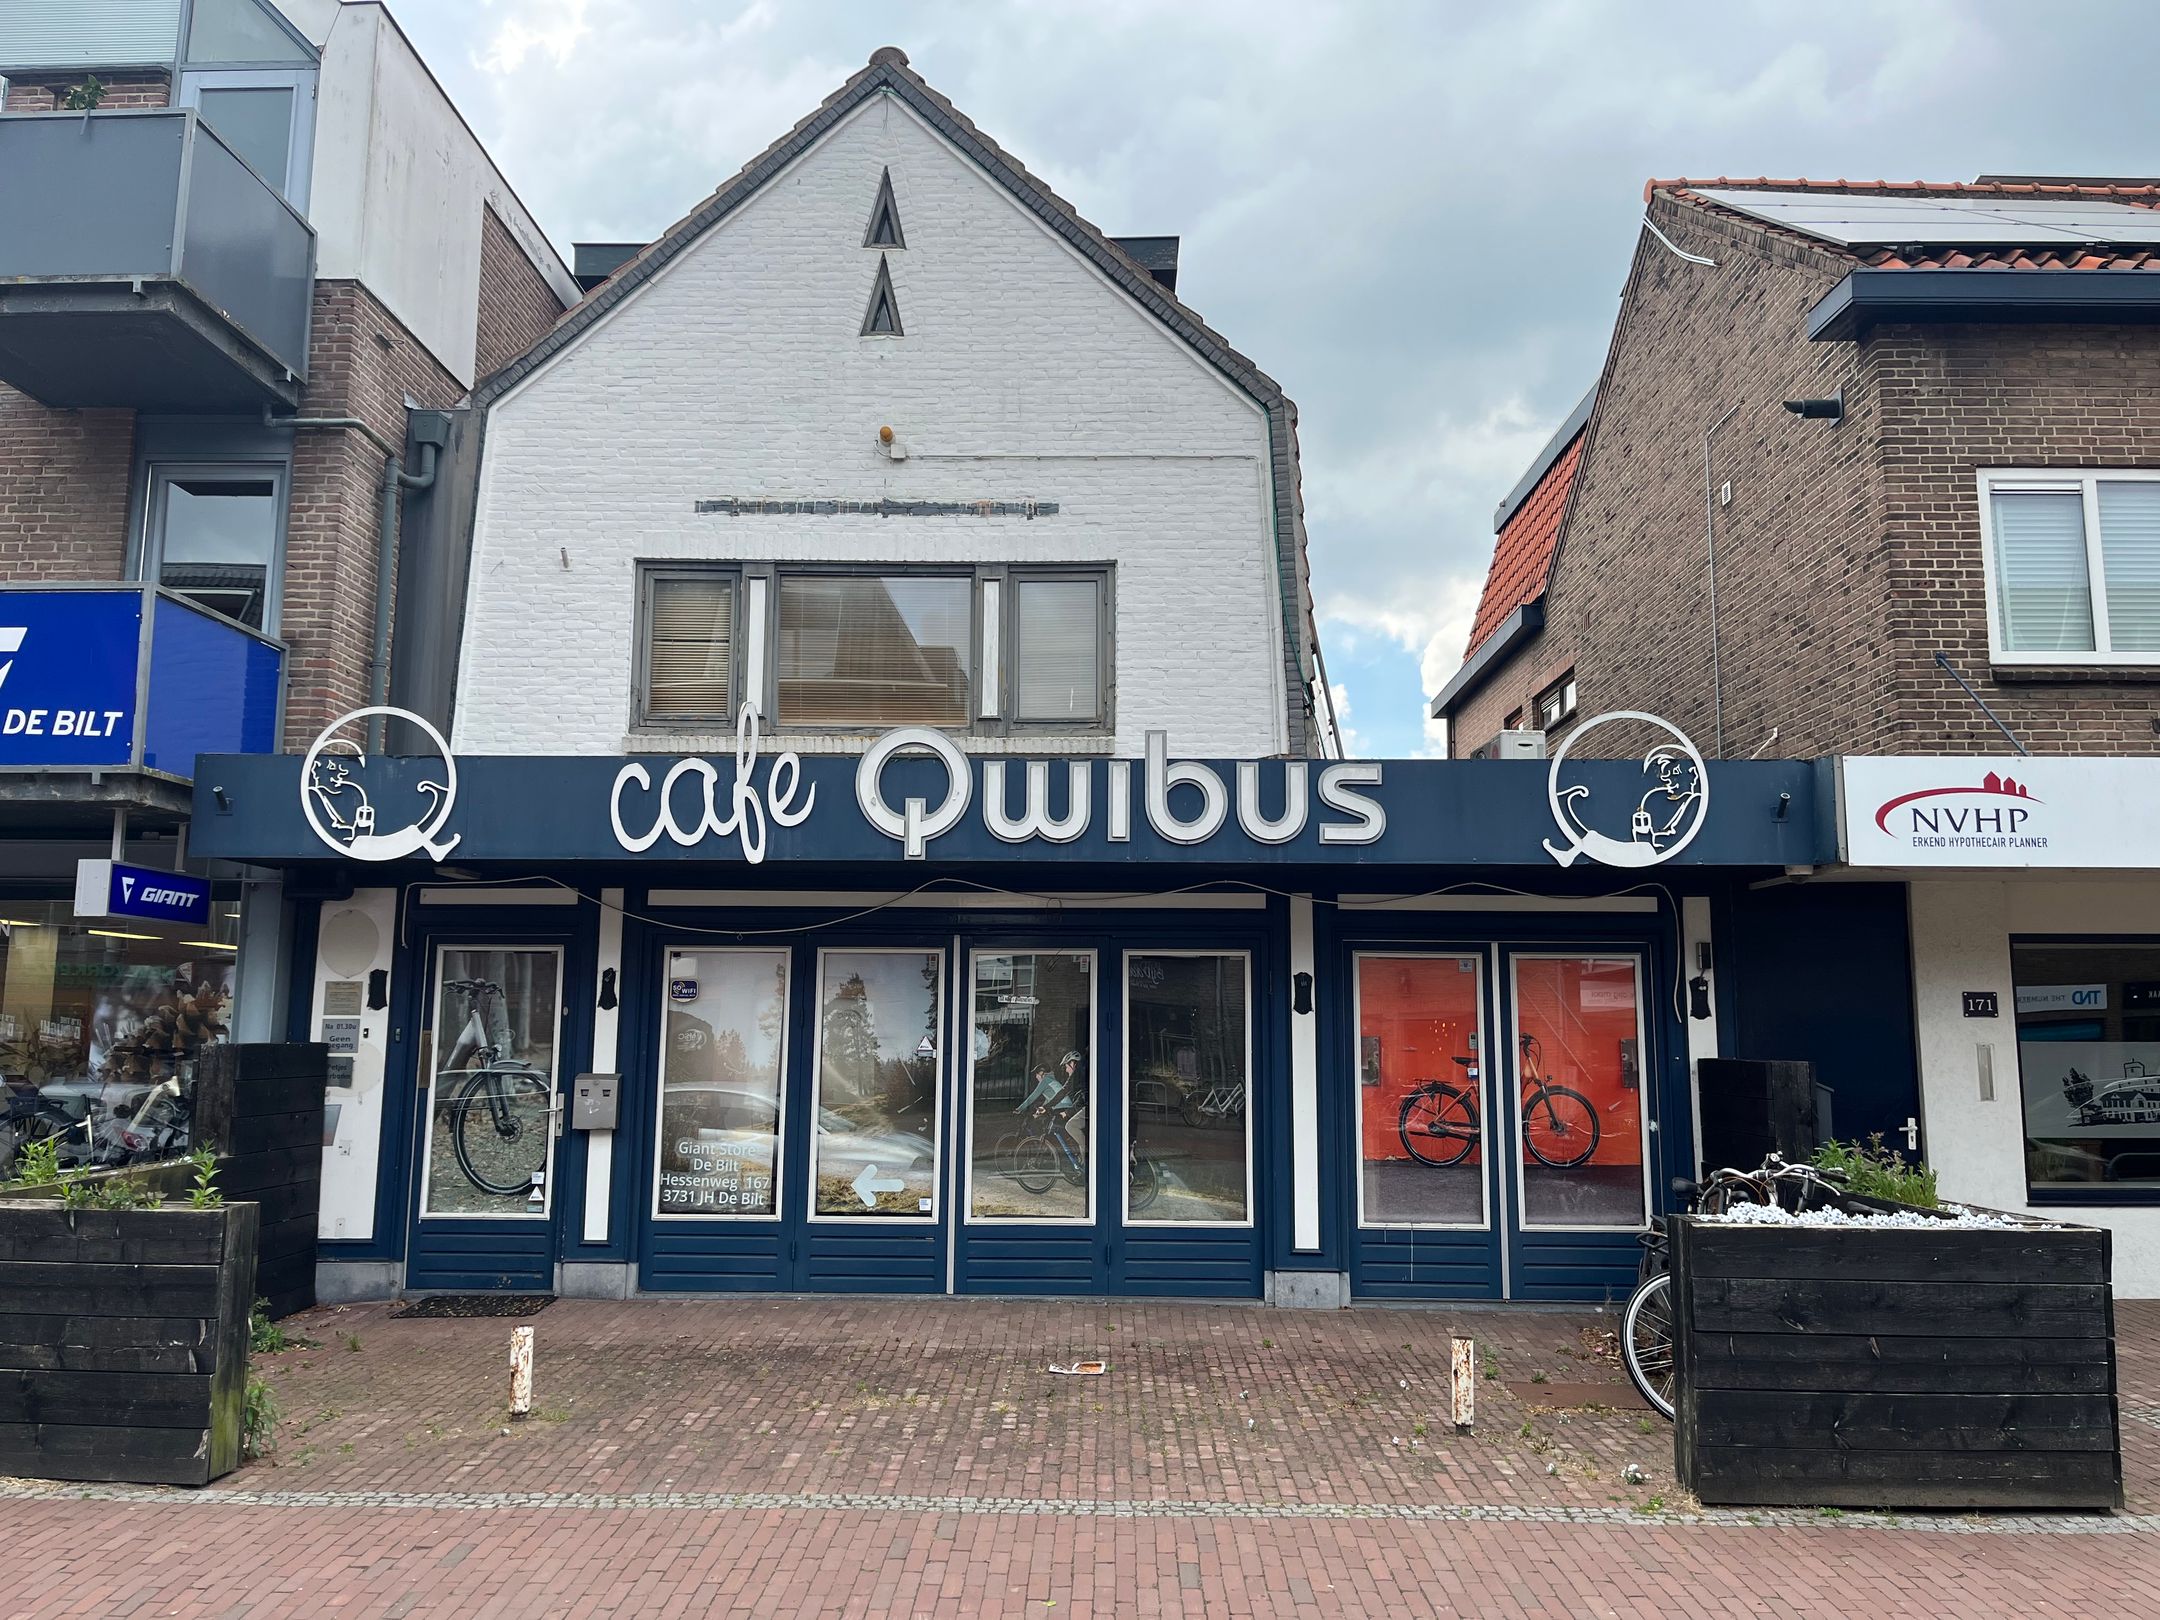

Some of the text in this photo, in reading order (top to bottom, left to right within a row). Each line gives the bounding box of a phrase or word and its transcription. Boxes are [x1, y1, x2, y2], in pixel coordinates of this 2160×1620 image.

[2, 708, 124, 737] DE BILT
[1911, 807, 2029, 833] NVHP
[1912, 836, 2048, 848] ERKEND HYPOTHECAIR PLANNER
[140, 886, 200, 908] GIANT
[1968, 999, 1993, 1011] 171
[679, 1141, 756, 1157] Giant Store
[693, 1158, 739, 1172] De Bilt
[660, 1173, 770, 1192] Hessenweg 167
[662, 1189, 764, 1206] 3731 JH De Bilt
